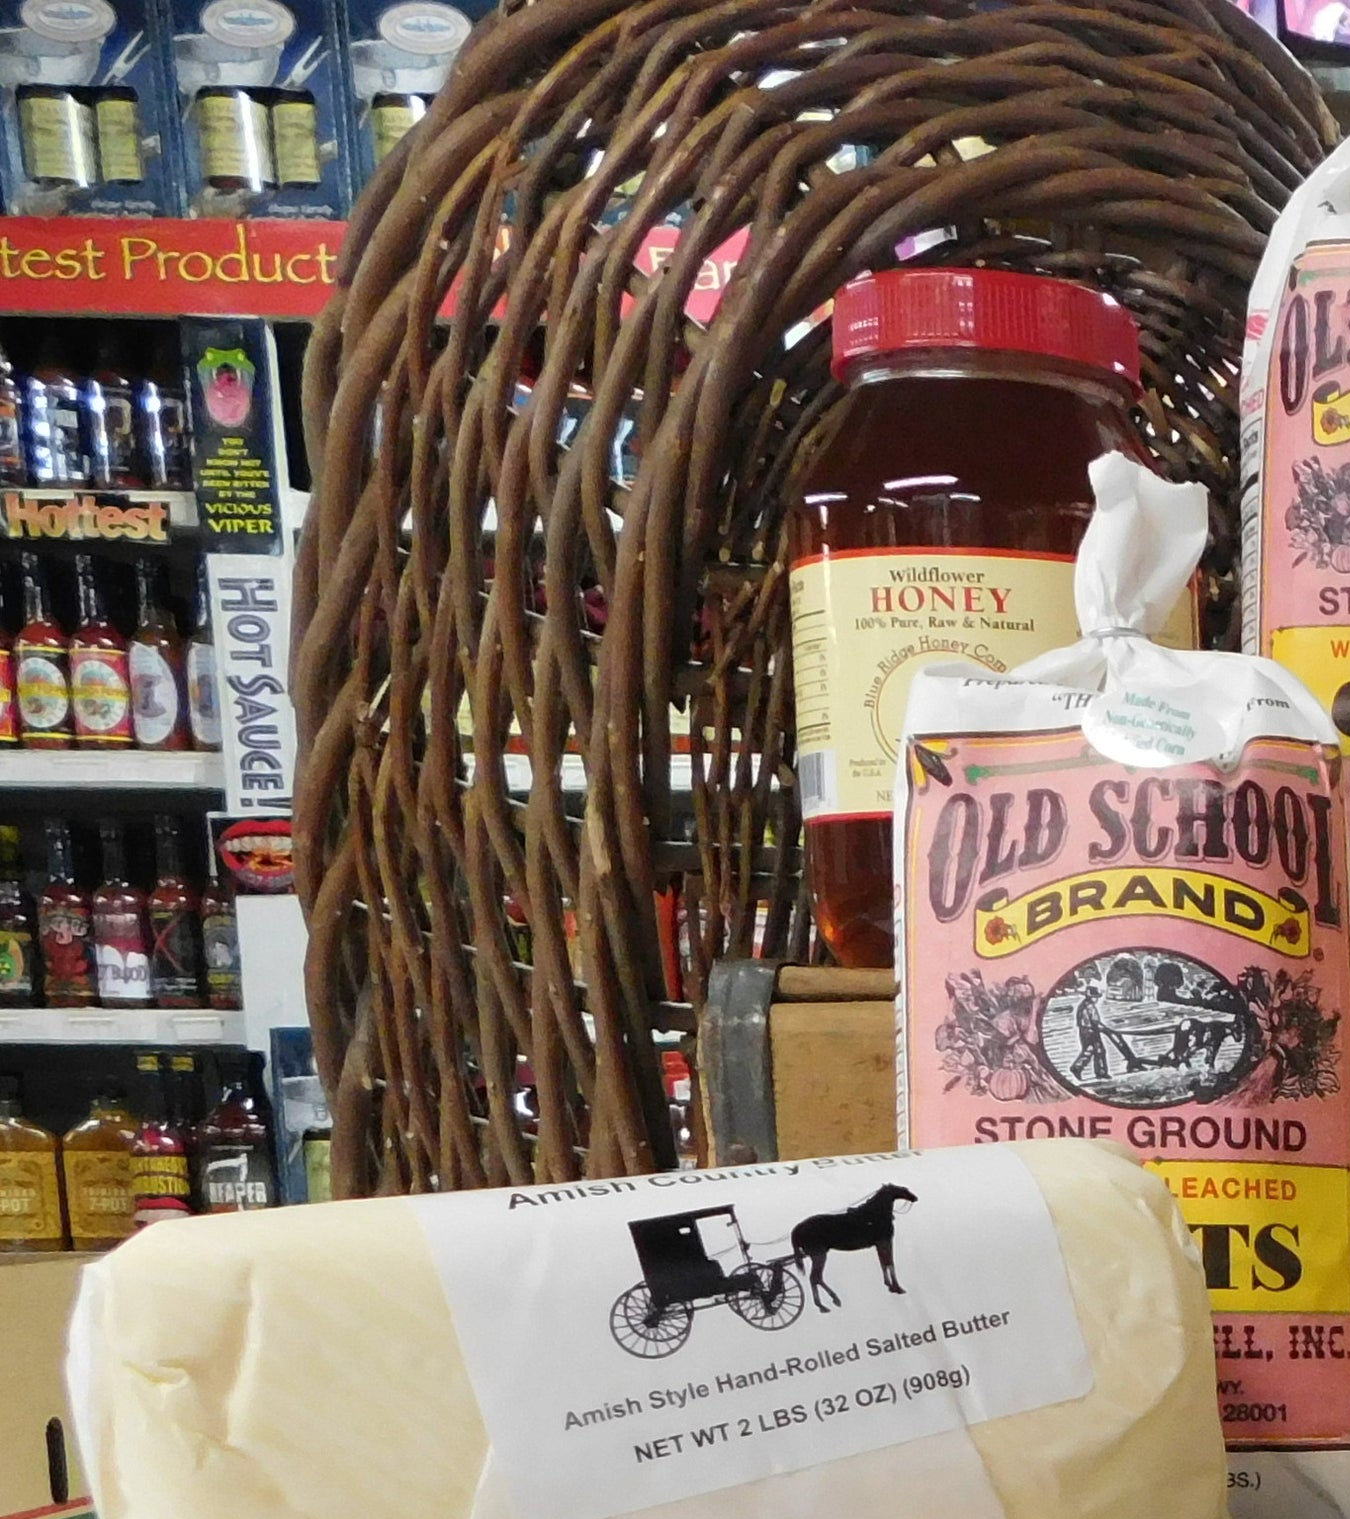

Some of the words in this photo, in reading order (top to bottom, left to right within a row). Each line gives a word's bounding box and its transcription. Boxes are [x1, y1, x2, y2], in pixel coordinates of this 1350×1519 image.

[4, 492, 167, 541] Hottest
[205, 503, 273, 515] VICIOUS
[207, 518, 274, 534] VIPER
[889, 567, 985, 584] Wildflower
[218, 578, 278, 668] HOT
[870, 585, 1013, 615] HONEY
[854, 616, 888, 631] 100%
[892, 617, 923, 632] Pure,
[928, 617, 959, 631] Raw
[962, 618, 975, 632] &
[980, 618, 1035, 633] Natural
[226, 674, 292, 809] SAUCE!
[927, 789, 1068, 924] OLD
[1088, 777, 1344, 932] SCHOOL
[1025, 875, 1265, 937] BRAND
[1127, 1116, 1307, 1152] GROUND
[508, 1175, 638, 1211] Amish
[647, 1163, 801, 1190] Country
[563, 1398, 644, 1433] Amish
[648, 1381, 711, 1411] Style
[715, 1343, 861, 1396] Hand-Rolled
[865, 1323, 938, 1357] Salted
[942, 1309, 1012, 1340] Butter
[633, 1435, 685, 1465] NET
[690, 1422, 730, 1448] WT
[737, 1418, 752, 1439] 2
[758, 1404, 809, 1434] LBS
[813, 1396, 850, 1425] (32
[856, 1383, 898, 1411] OZ)
[902, 1365, 971, 1401] (908g)
